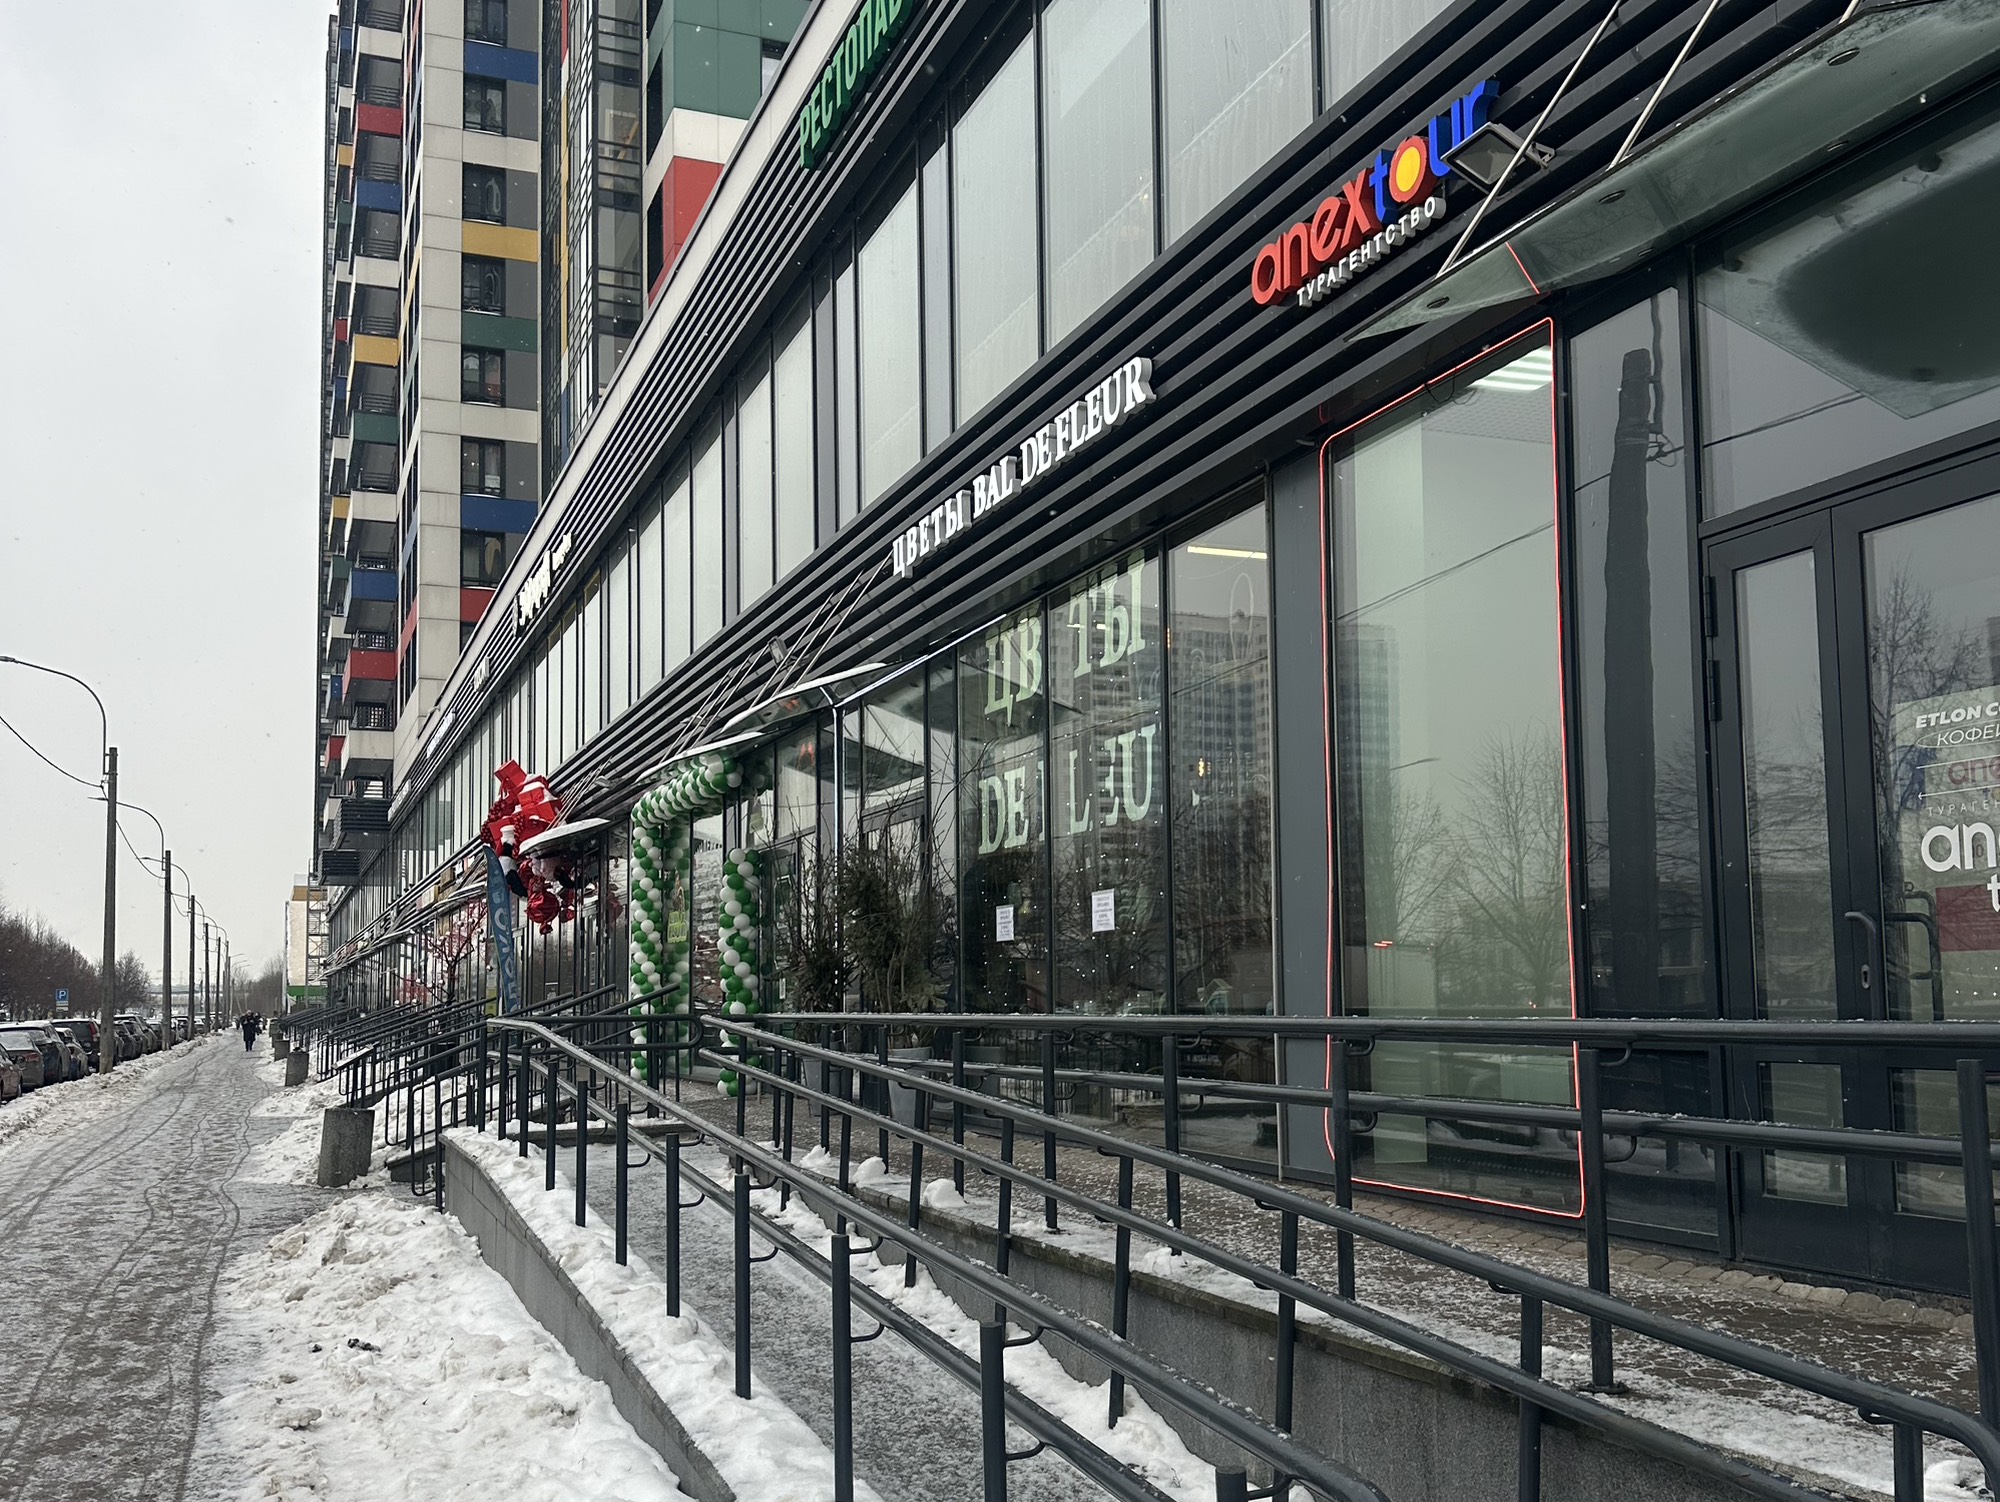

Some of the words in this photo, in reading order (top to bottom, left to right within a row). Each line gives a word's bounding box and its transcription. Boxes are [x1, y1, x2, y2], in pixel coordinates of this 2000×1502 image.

[1297, 197, 1446, 307] ТУРАГЕНТСТВО
[892, 490, 971, 578] ЦВЕТЫ
[973, 456, 1021, 519] BAL
[1019, 423, 1058, 486] DE
[1054, 357, 1157, 462] FLEUR
[1915, 705, 1982, 729] ETLON
[1920, 822, 2000, 872] an
